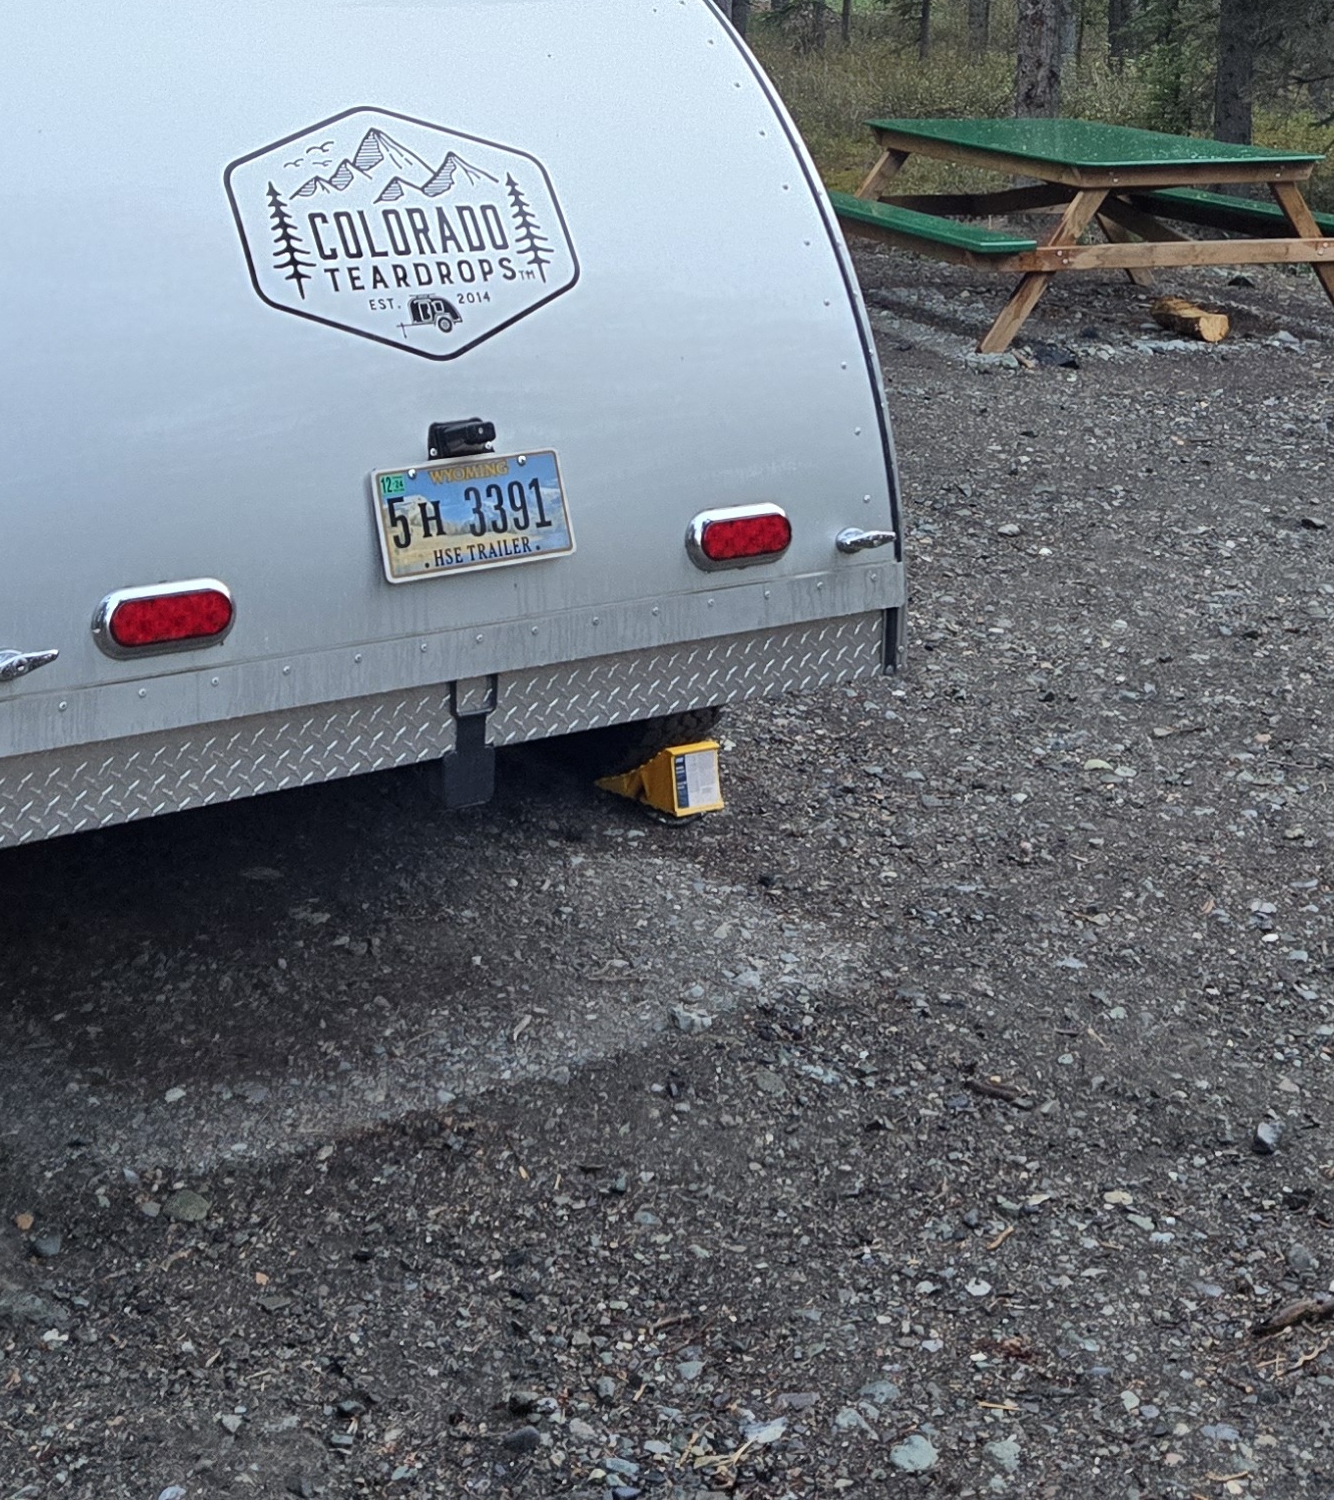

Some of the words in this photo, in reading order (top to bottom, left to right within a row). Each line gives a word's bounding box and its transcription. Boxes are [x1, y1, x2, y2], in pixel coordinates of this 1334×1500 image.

[308, 204, 510, 261] COLORADO
[323, 257, 517, 292] TEARDROPS
[369, 298, 402, 311] EST.
[456, 291, 491, 305] 2014
[380, 476, 393, 494] 12
[429, 459, 510, 486] WYOMING
[463, 477, 552, 537] 3391
[433, 549, 464, 568] HSE
[467, 536, 533, 562] TRAILER
